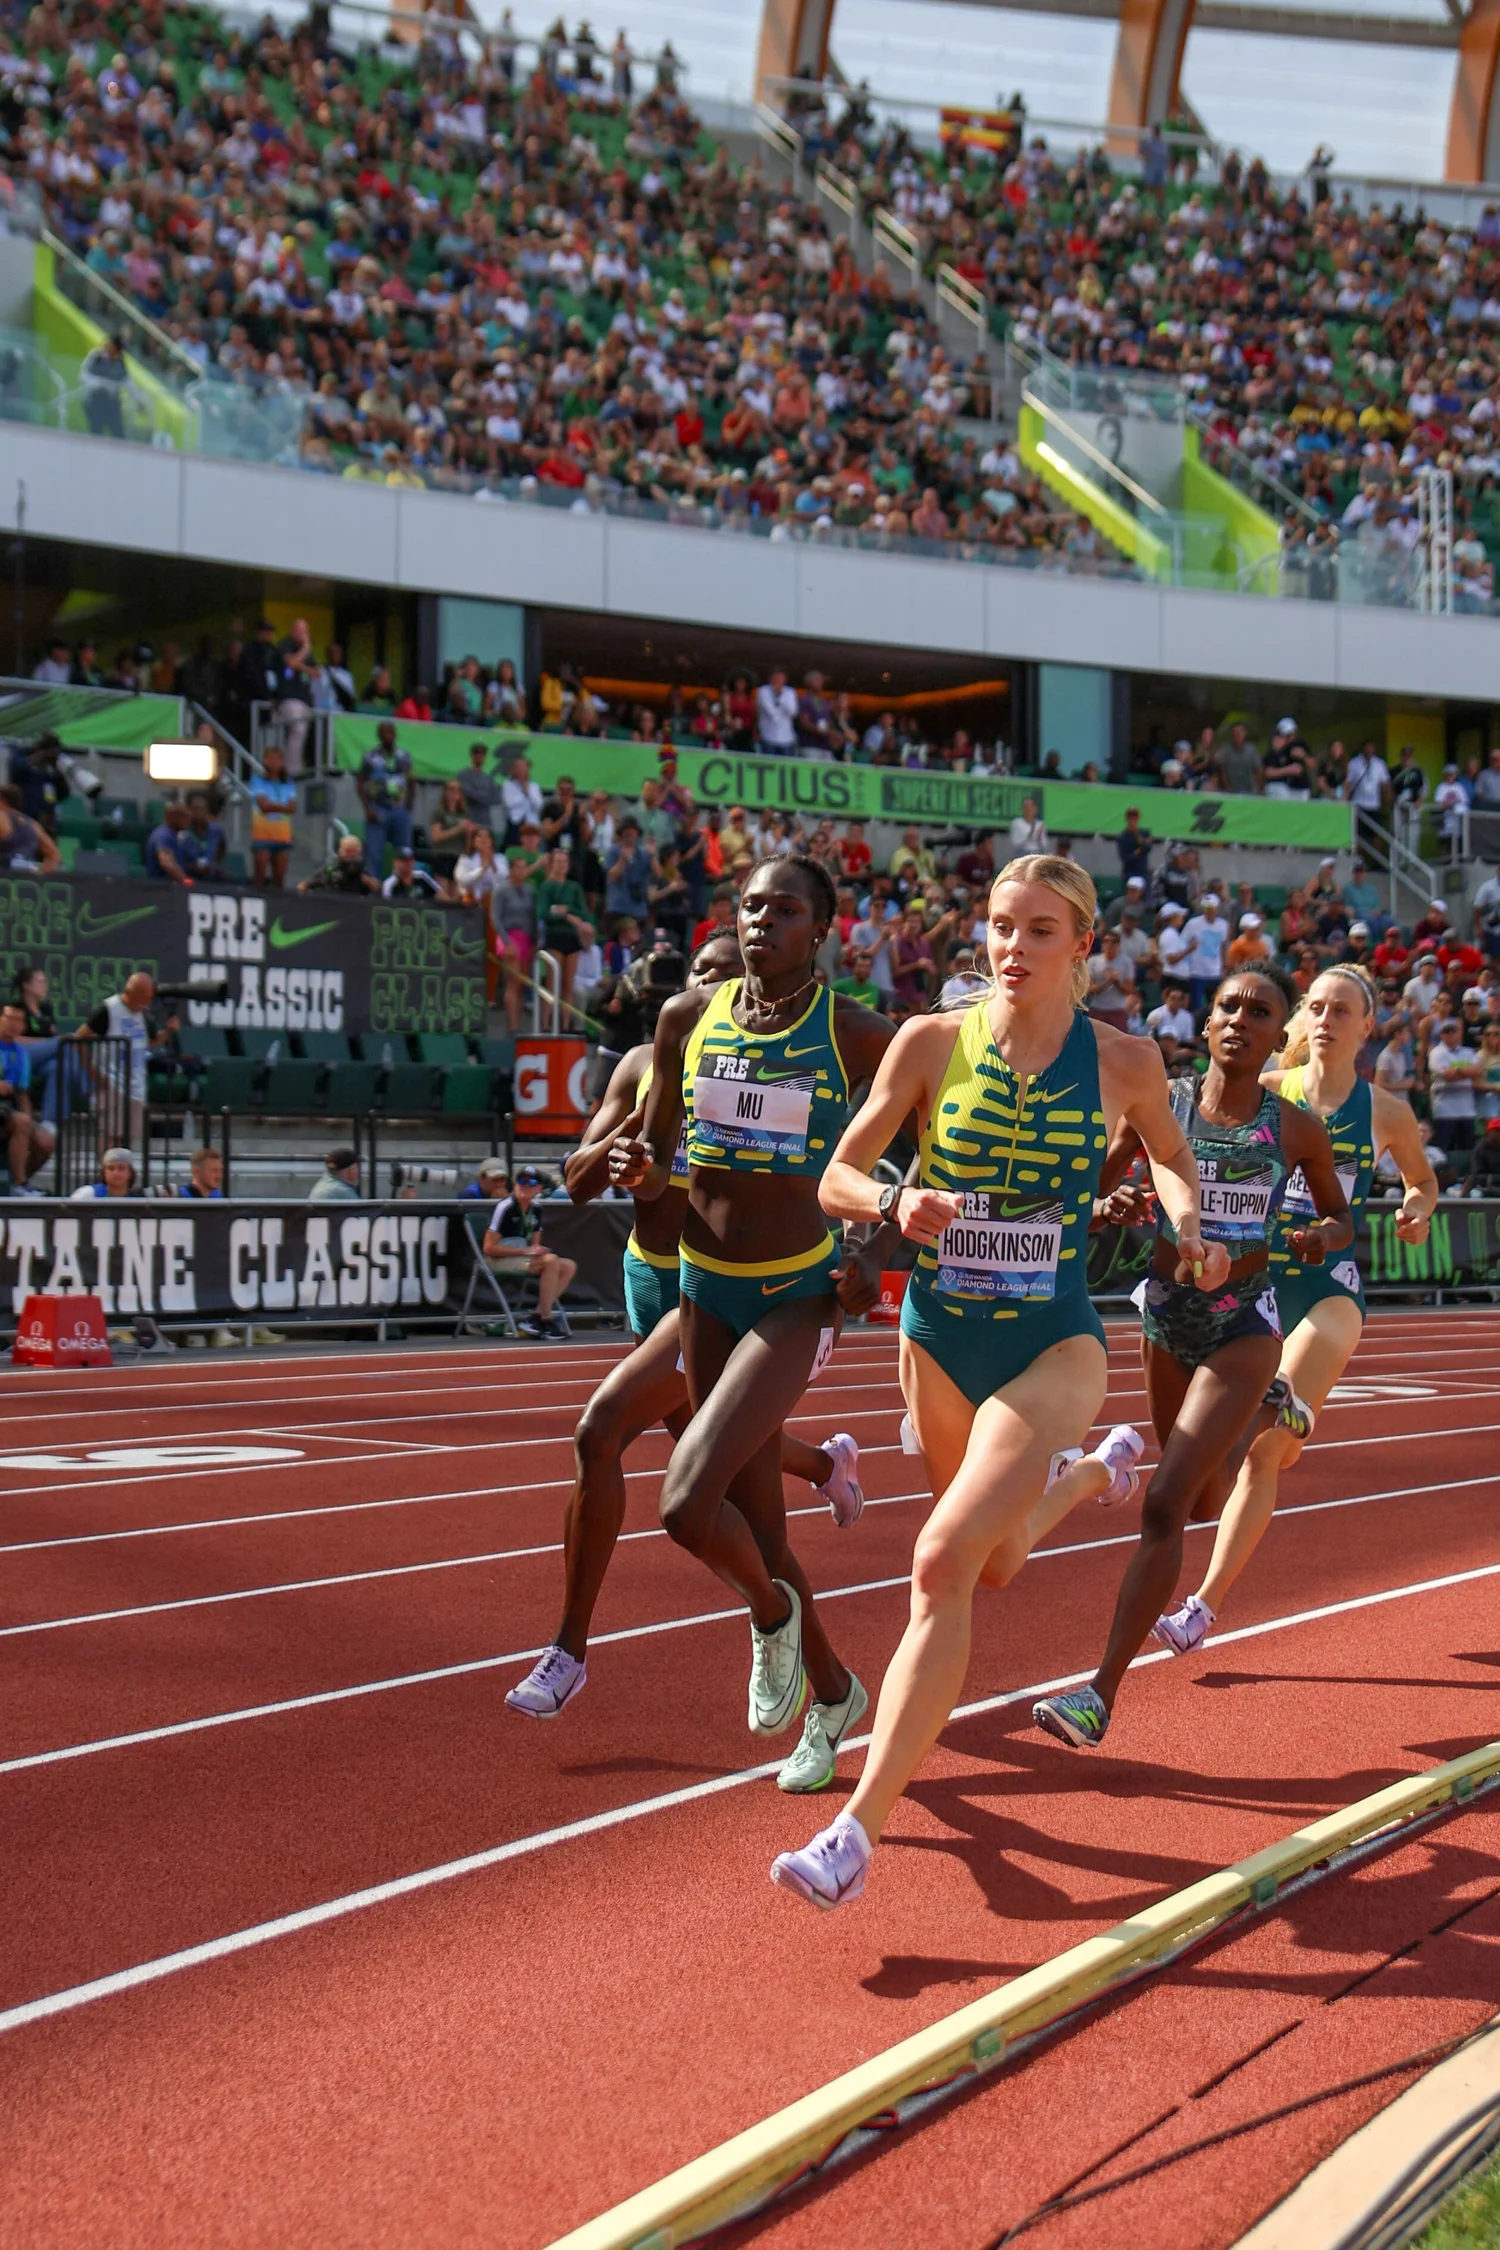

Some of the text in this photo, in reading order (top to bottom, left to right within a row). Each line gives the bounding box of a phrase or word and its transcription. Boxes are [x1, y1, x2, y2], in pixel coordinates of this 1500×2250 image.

[699, 758, 850, 808] CITIUS
[187, 893, 266, 962] PRE
[371, 906, 446, 972] PRE
[187, 963, 344, 1033] CLASSIC
[713, 1055, 750, 1081] PRE
[515, 1054, 548, 1114] G
[736, 1091, 764, 1120] MU
[712, 1131, 802, 1151] DIAMOND LEAGUE FINAL
[1196, 1160, 1217, 1181] RE
[954, 1190, 990, 1219] RE
[1200, 1189, 1268, 1215] LE-TOPPIN
[943, 1227, 1055, 1262] HODGKINSON
[1200, 1225, 1220, 1235] MOND
[0, 1215, 449, 1315] TAINE CLASSIC
[956, 1278, 1051, 1292] DIAMOND LEAGUE FINAL
[16, 1335, 109, 1352] OMEGA OMEGA
